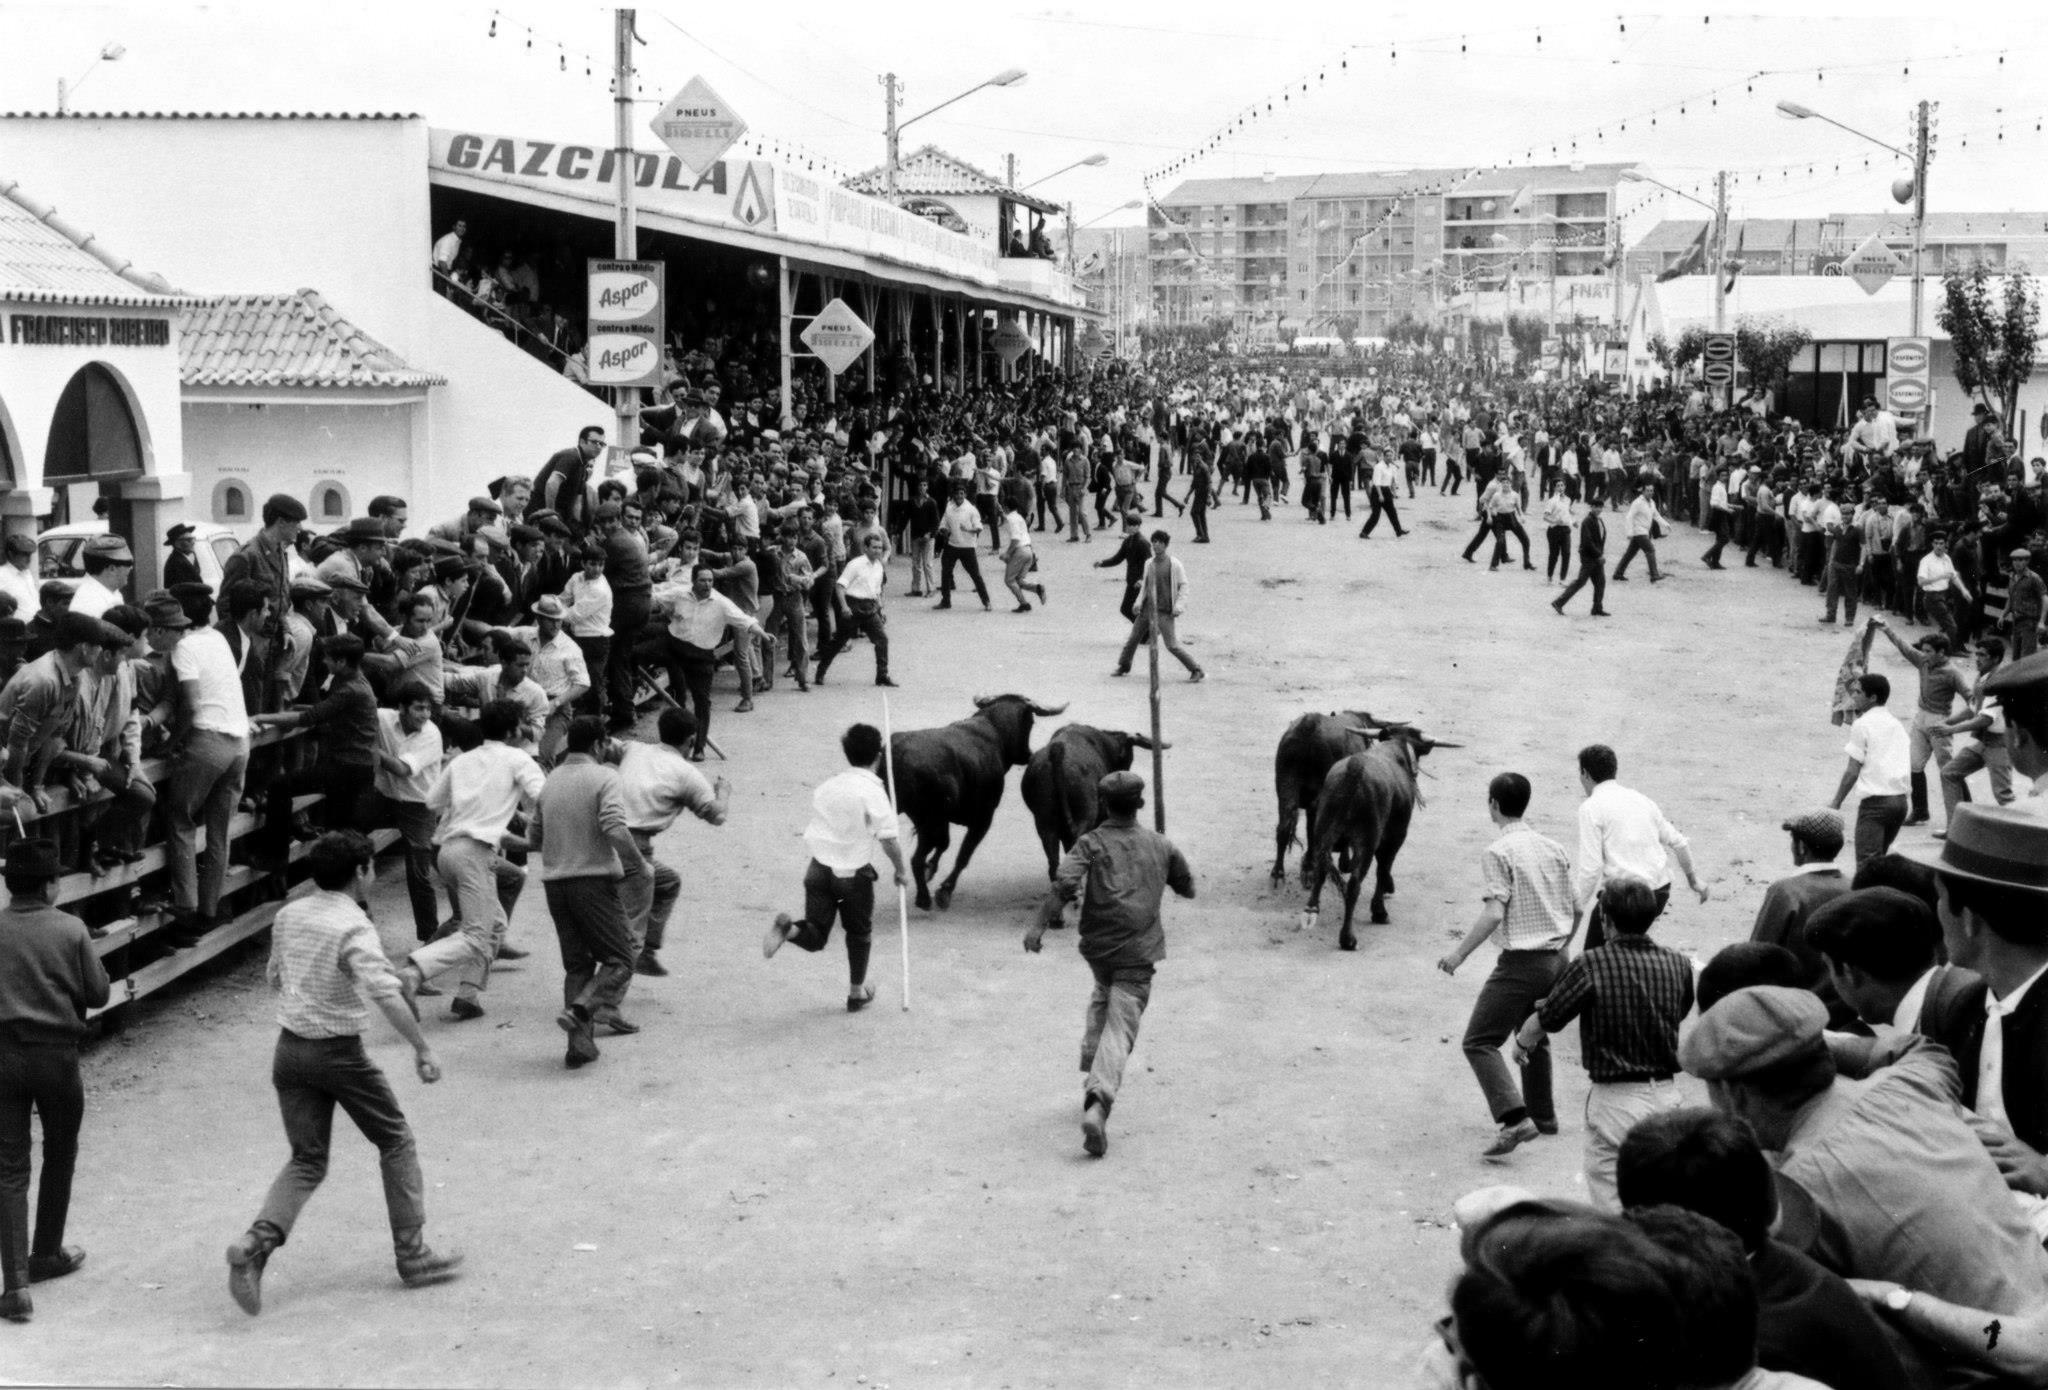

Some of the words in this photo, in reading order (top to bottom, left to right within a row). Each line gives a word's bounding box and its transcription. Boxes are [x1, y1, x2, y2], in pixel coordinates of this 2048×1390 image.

[676, 109, 717, 118] PNEUS
[599, 280, 648, 308] Aspor
[599, 341, 648, 369] Aspor
